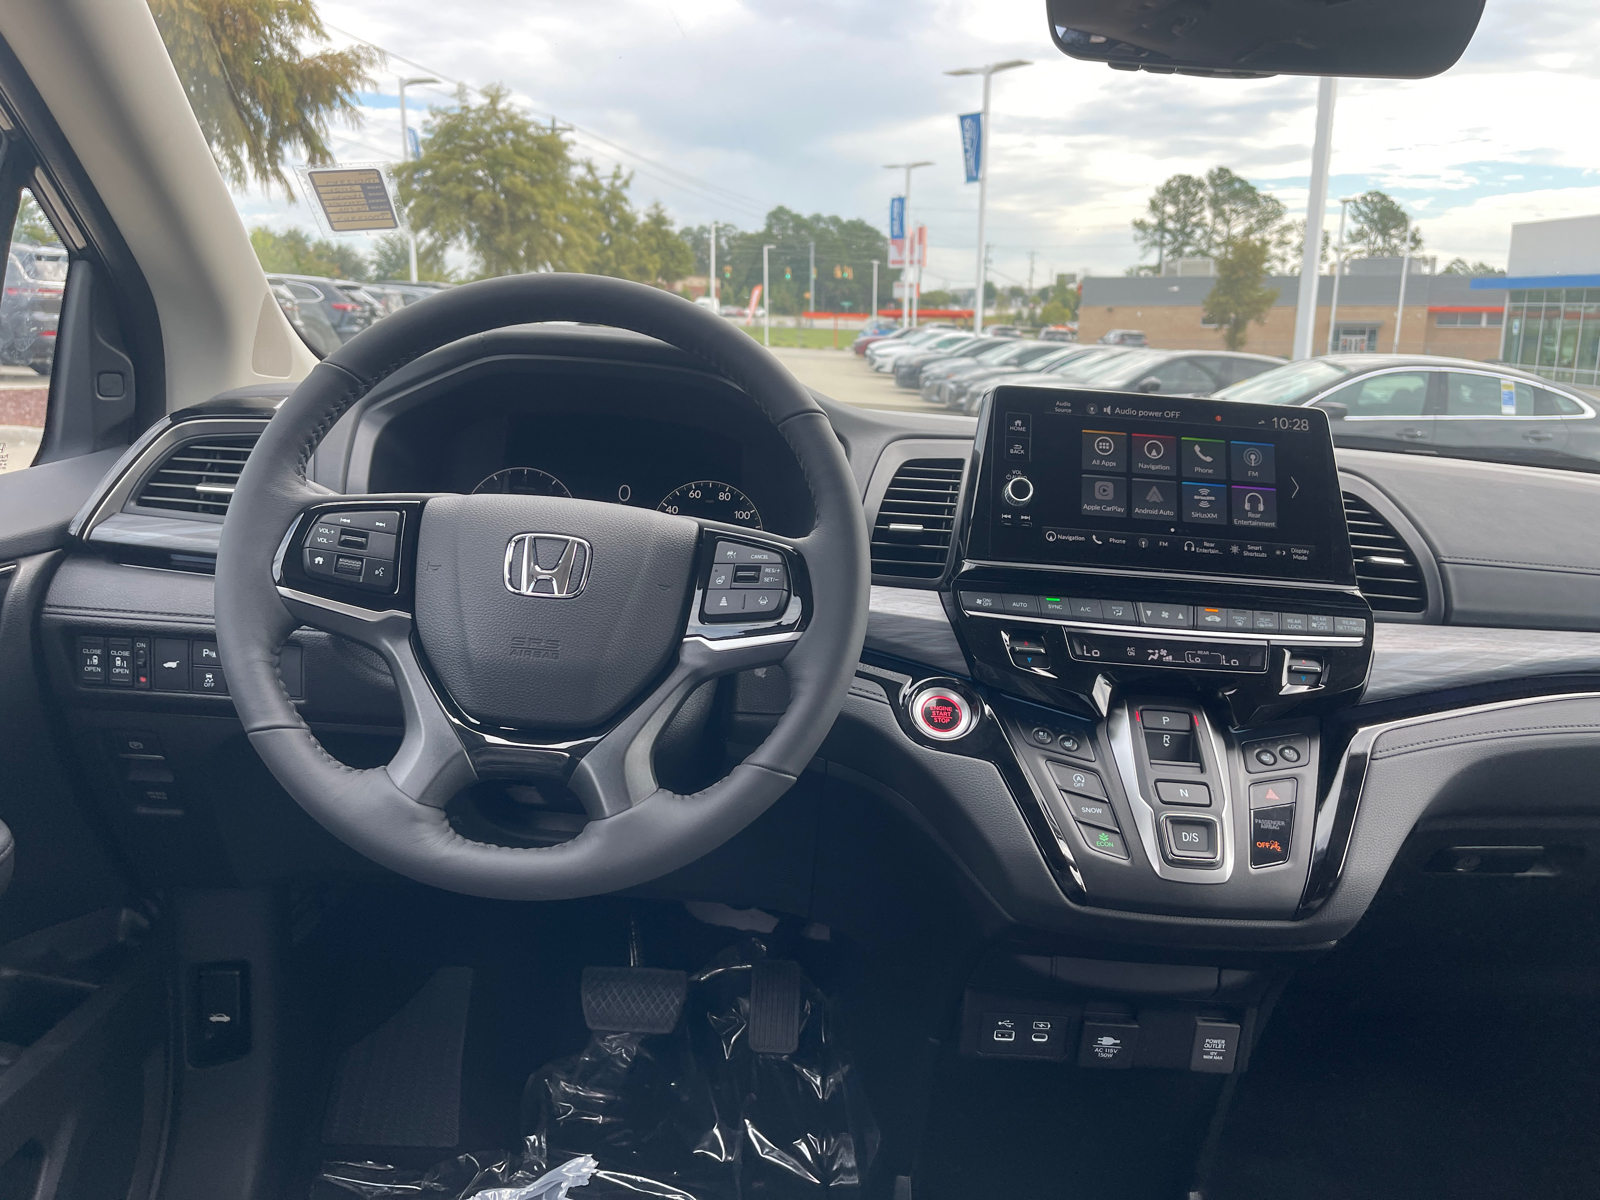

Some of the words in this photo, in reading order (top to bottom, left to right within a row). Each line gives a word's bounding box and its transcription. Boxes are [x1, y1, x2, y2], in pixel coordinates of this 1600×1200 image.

[1115, 407, 1137, 416] Audio
[1138, 410, 1162, 418] power
[1164, 411, 1181, 419] OFF
[1271, 417, 1309, 431] 10:28
[1138, 463, 1170, 471] Navigation
[1194, 466, 1213, 474] Phone
[618, 484, 631, 502] 0
[688, 490, 701, 499] 60
[718, 492, 731, 501] 80
[665, 505, 679, 514] 40
[1101, 505, 1125, 513] CarPlay
[1134, 507, 1158, 515] Android
[734, 511, 751, 520] 100
[1191, 511, 1218, 519] SiriusXM
[1234, 519, 1275, 527] Entertainment
[1057, 534, 1085, 542] Navigation
[1290, 547, 1309, 555] Display
[510, 650, 560, 660] AIRBAG
[1083, 645, 1100, 657] Lo
[1188, 653, 1201, 663] Lo
[1222, 655, 1239, 666] Lo
[1162, 716, 1170, 725] P
[1163, 734, 1171, 743] R
[1179, 788, 1189, 798] N
[1081, 806, 1102, 814] SNOW
[1255, 818, 1285, 826] PASSENGER
[1181, 831, 1199, 843] D/S
[1256, 840, 1270, 848] OFF
